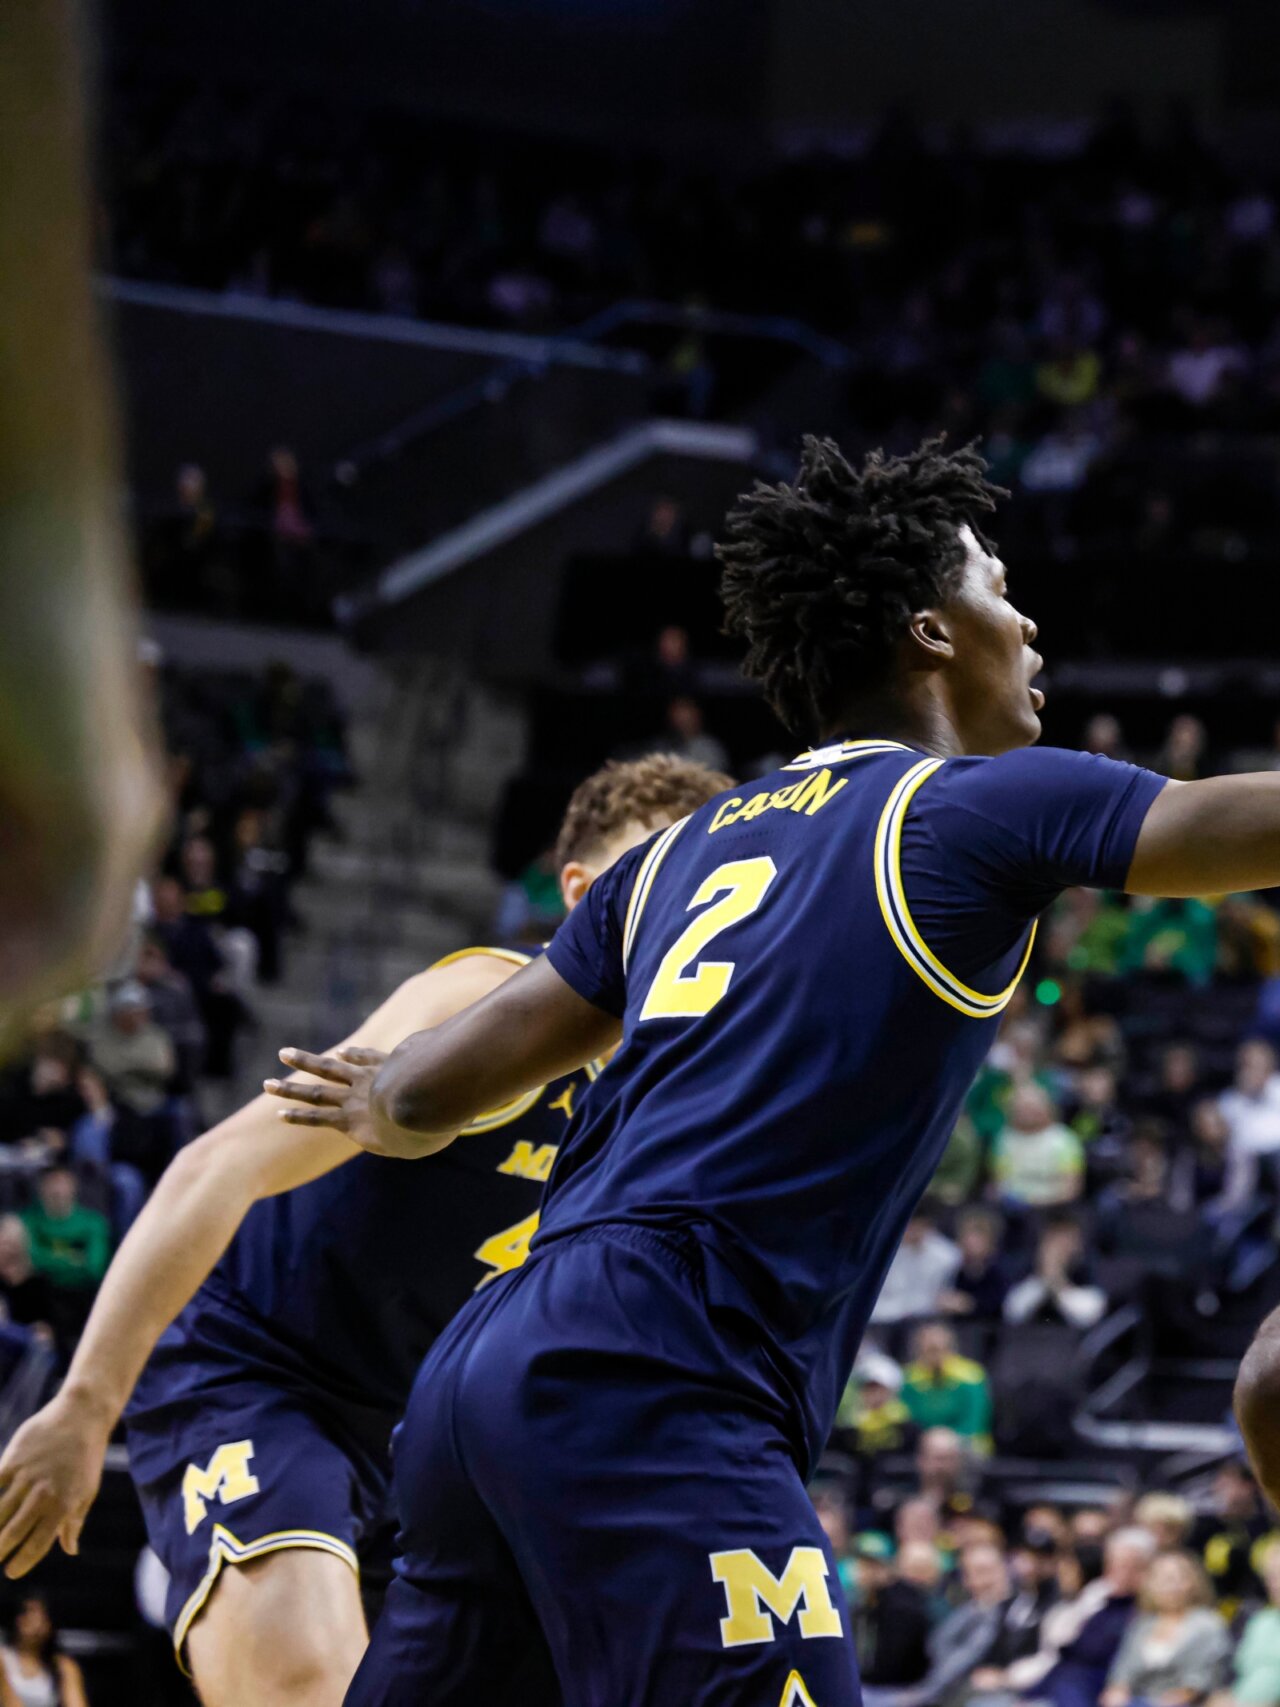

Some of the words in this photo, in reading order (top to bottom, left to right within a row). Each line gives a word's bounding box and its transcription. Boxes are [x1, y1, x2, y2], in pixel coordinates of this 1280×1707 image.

[639, 856, 779, 1021] 2
[182, 1439, 260, 1536] M
[709, 1546, 844, 1648] M
